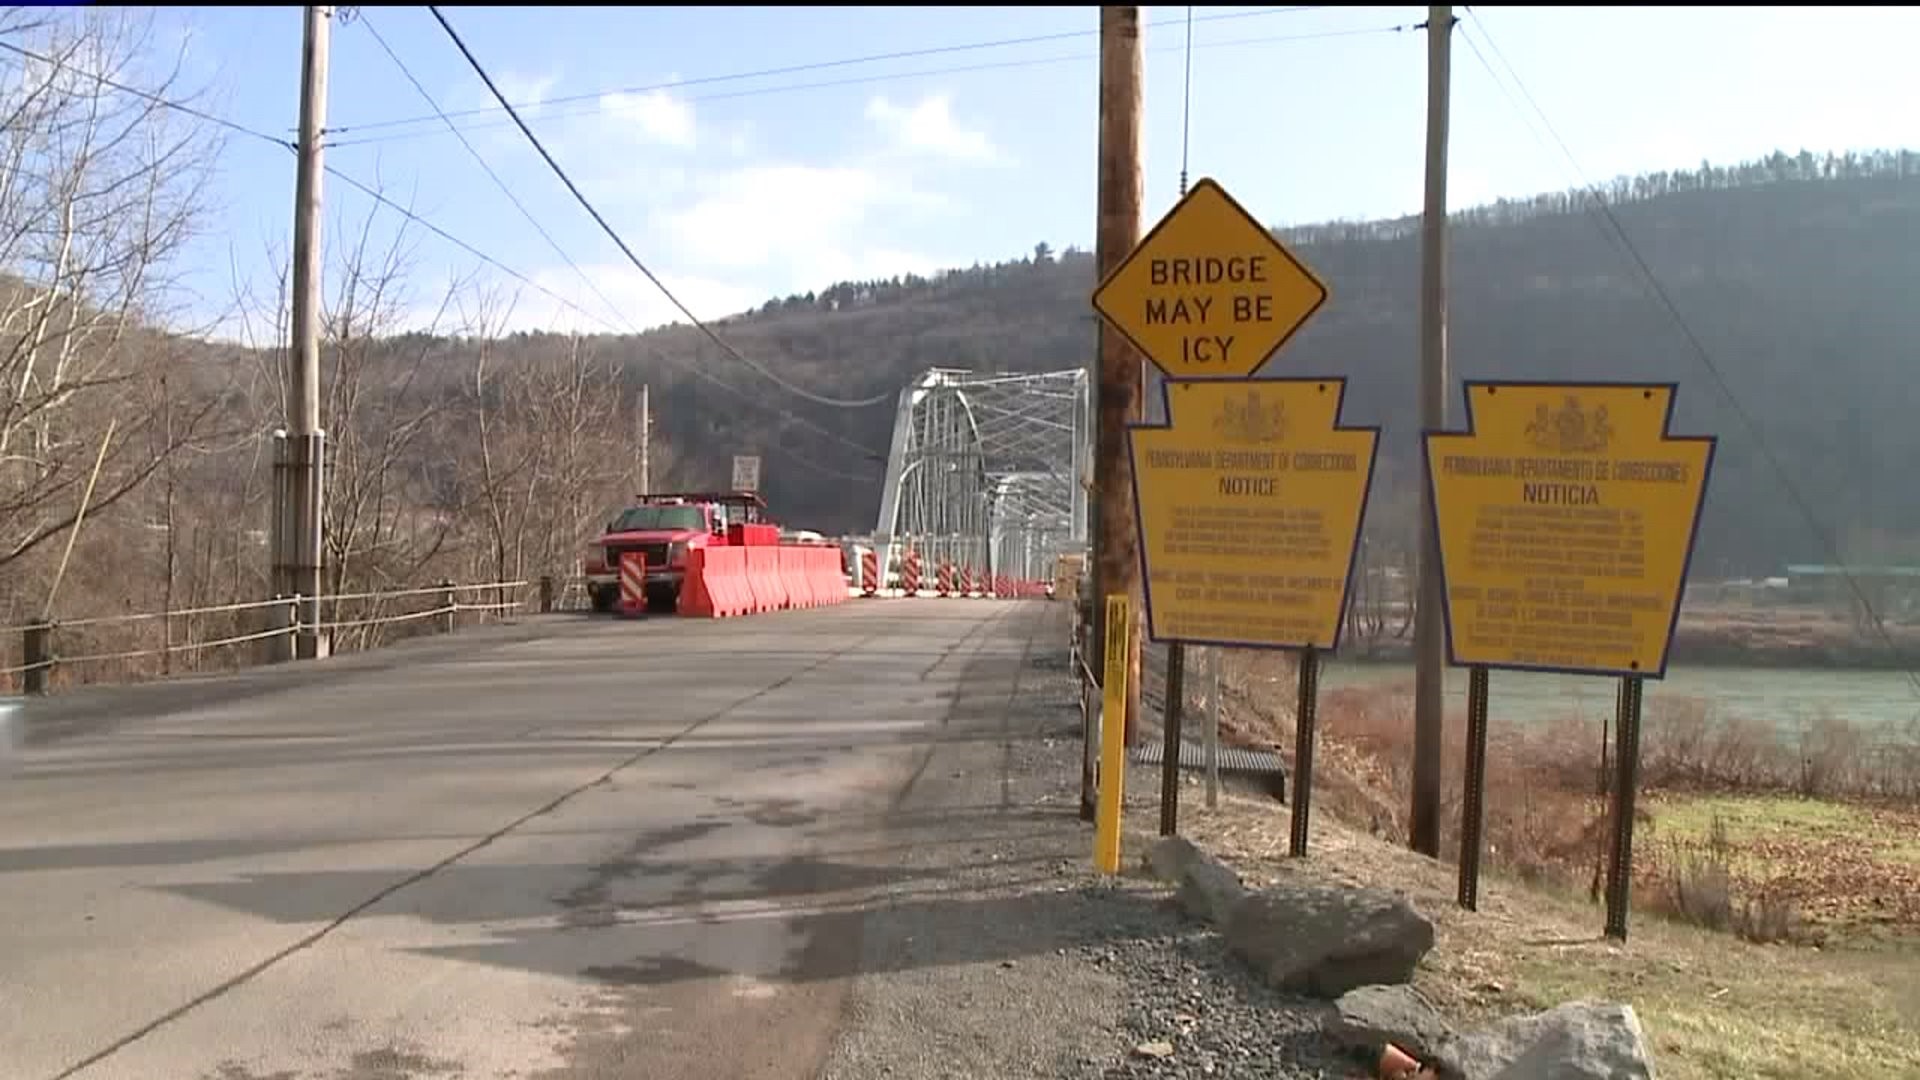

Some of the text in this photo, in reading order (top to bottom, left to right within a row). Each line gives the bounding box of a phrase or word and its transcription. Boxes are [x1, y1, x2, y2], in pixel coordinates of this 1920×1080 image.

[1151, 256, 1267, 285] BRIDGE
[1146, 296, 1273, 325] MAY BE
[1182, 336, 1234, 363] ICY
[1219, 477, 1278, 496] NOTICE
[1523, 483, 1600, 505] NOTICIA
